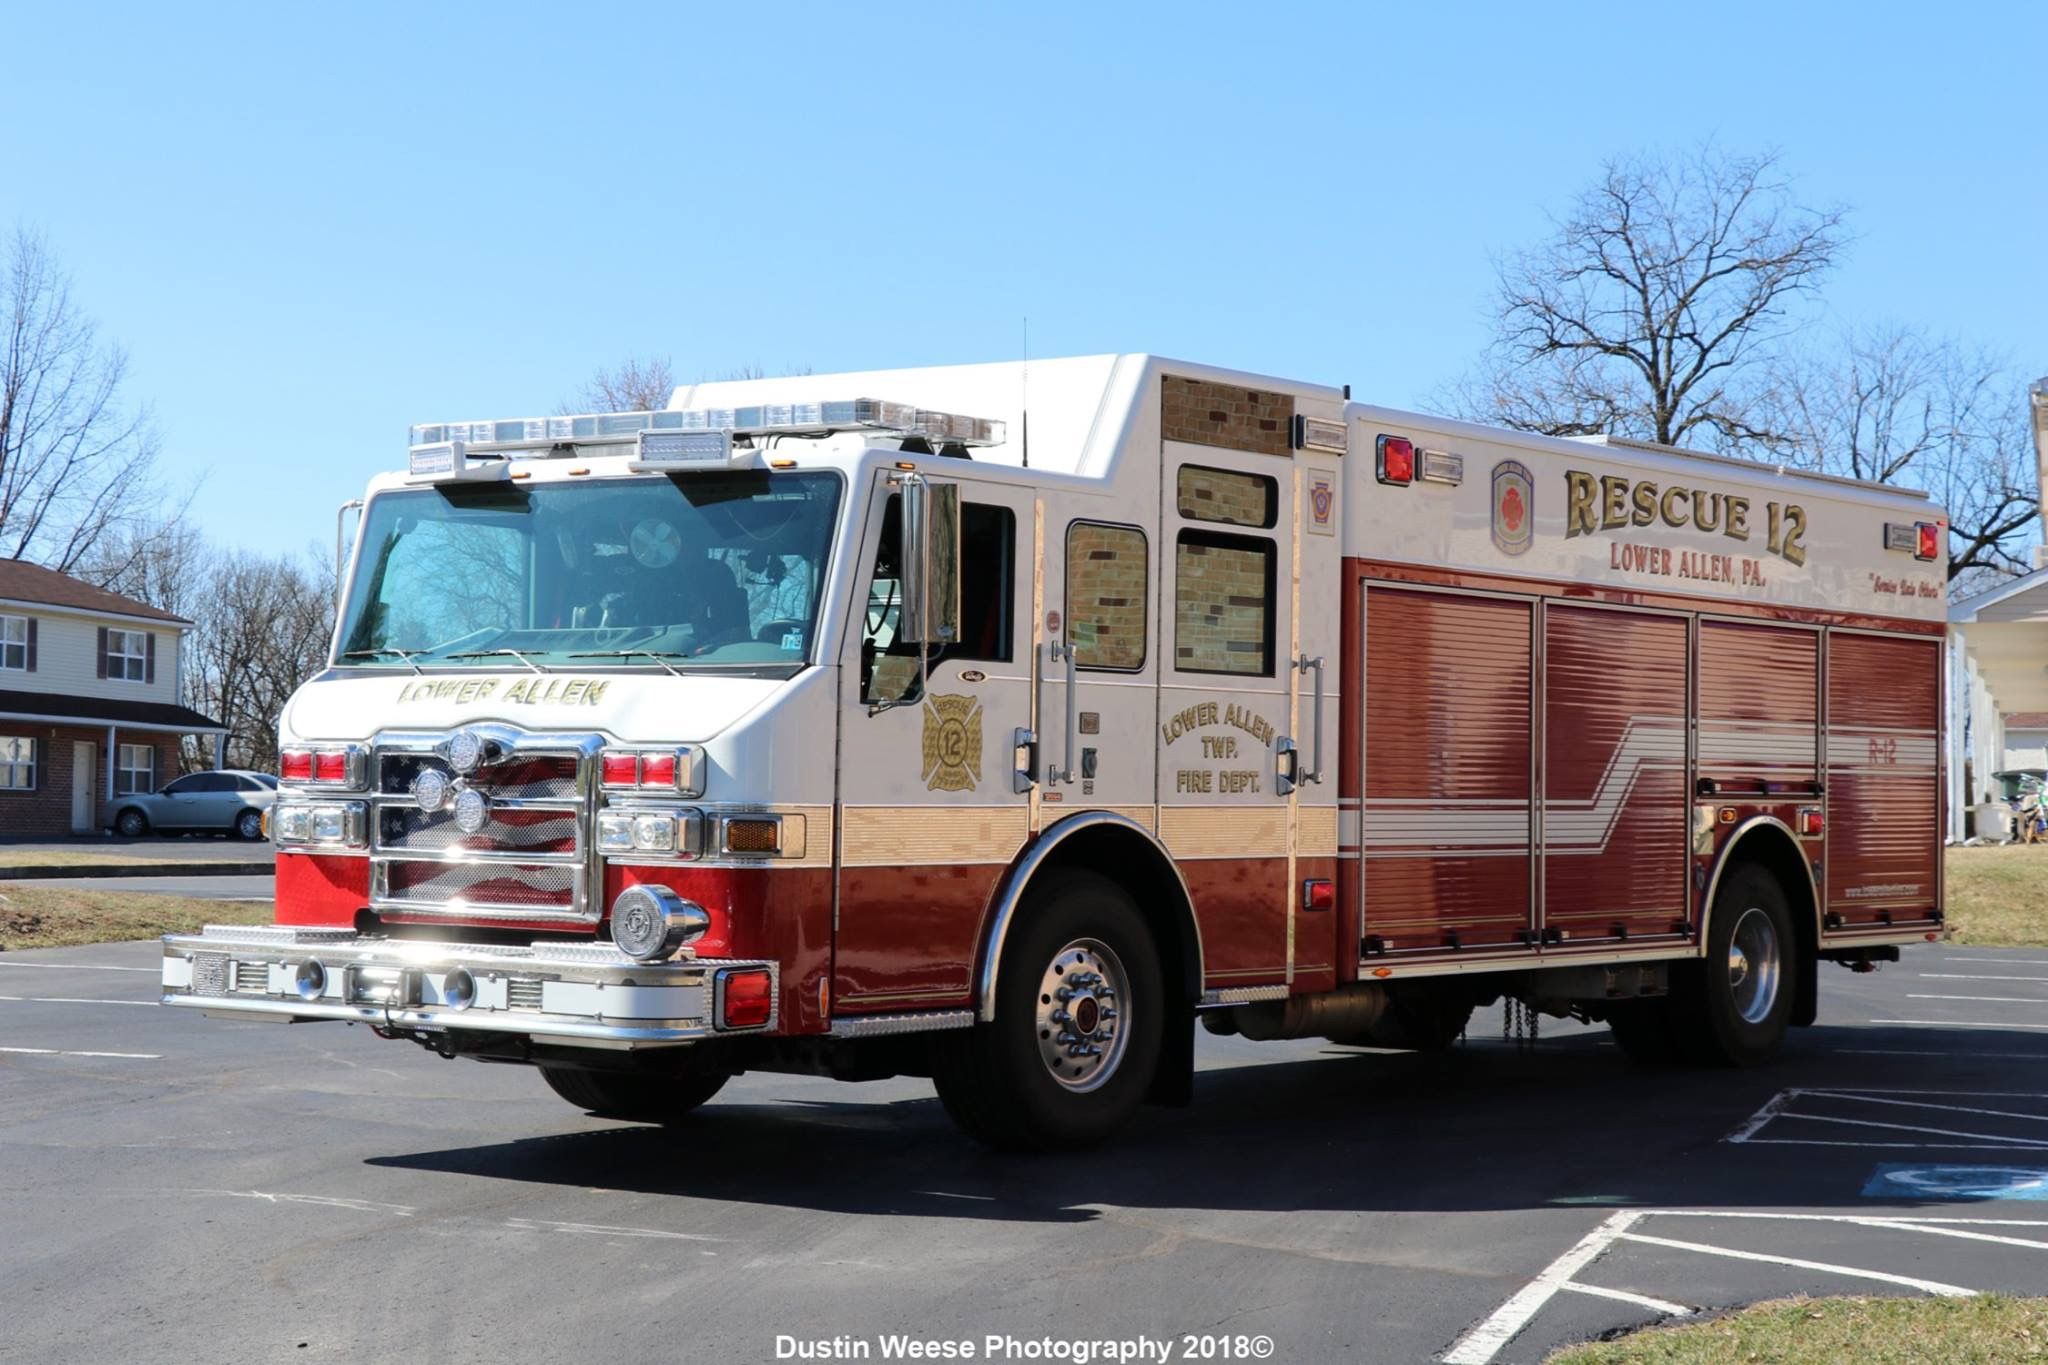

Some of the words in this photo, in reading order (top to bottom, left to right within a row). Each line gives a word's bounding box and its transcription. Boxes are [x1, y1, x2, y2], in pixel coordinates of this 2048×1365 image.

[1565, 470, 1750, 541] RESCUE
[1766, 501, 1808, 567] 12
[1610, 542, 1673, 577] LOWER
[1678, 549, 1736, 585] ALLEN,
[1742, 558, 1767, 587] PA.
[397, 678, 499, 704] LOWER
[502, 678, 609, 705] ALLEN
[1162, 701, 1219, 746] LOWER
[1223, 703, 1275, 748] ALLEN
[944, 730, 961, 756] 12
[1201, 735, 1239, 759] TWP.
[1868, 738, 1897, 765] R-12
[1176, 769, 1213, 794] FIRE
[1219, 770, 1261, 794] DEPT.
